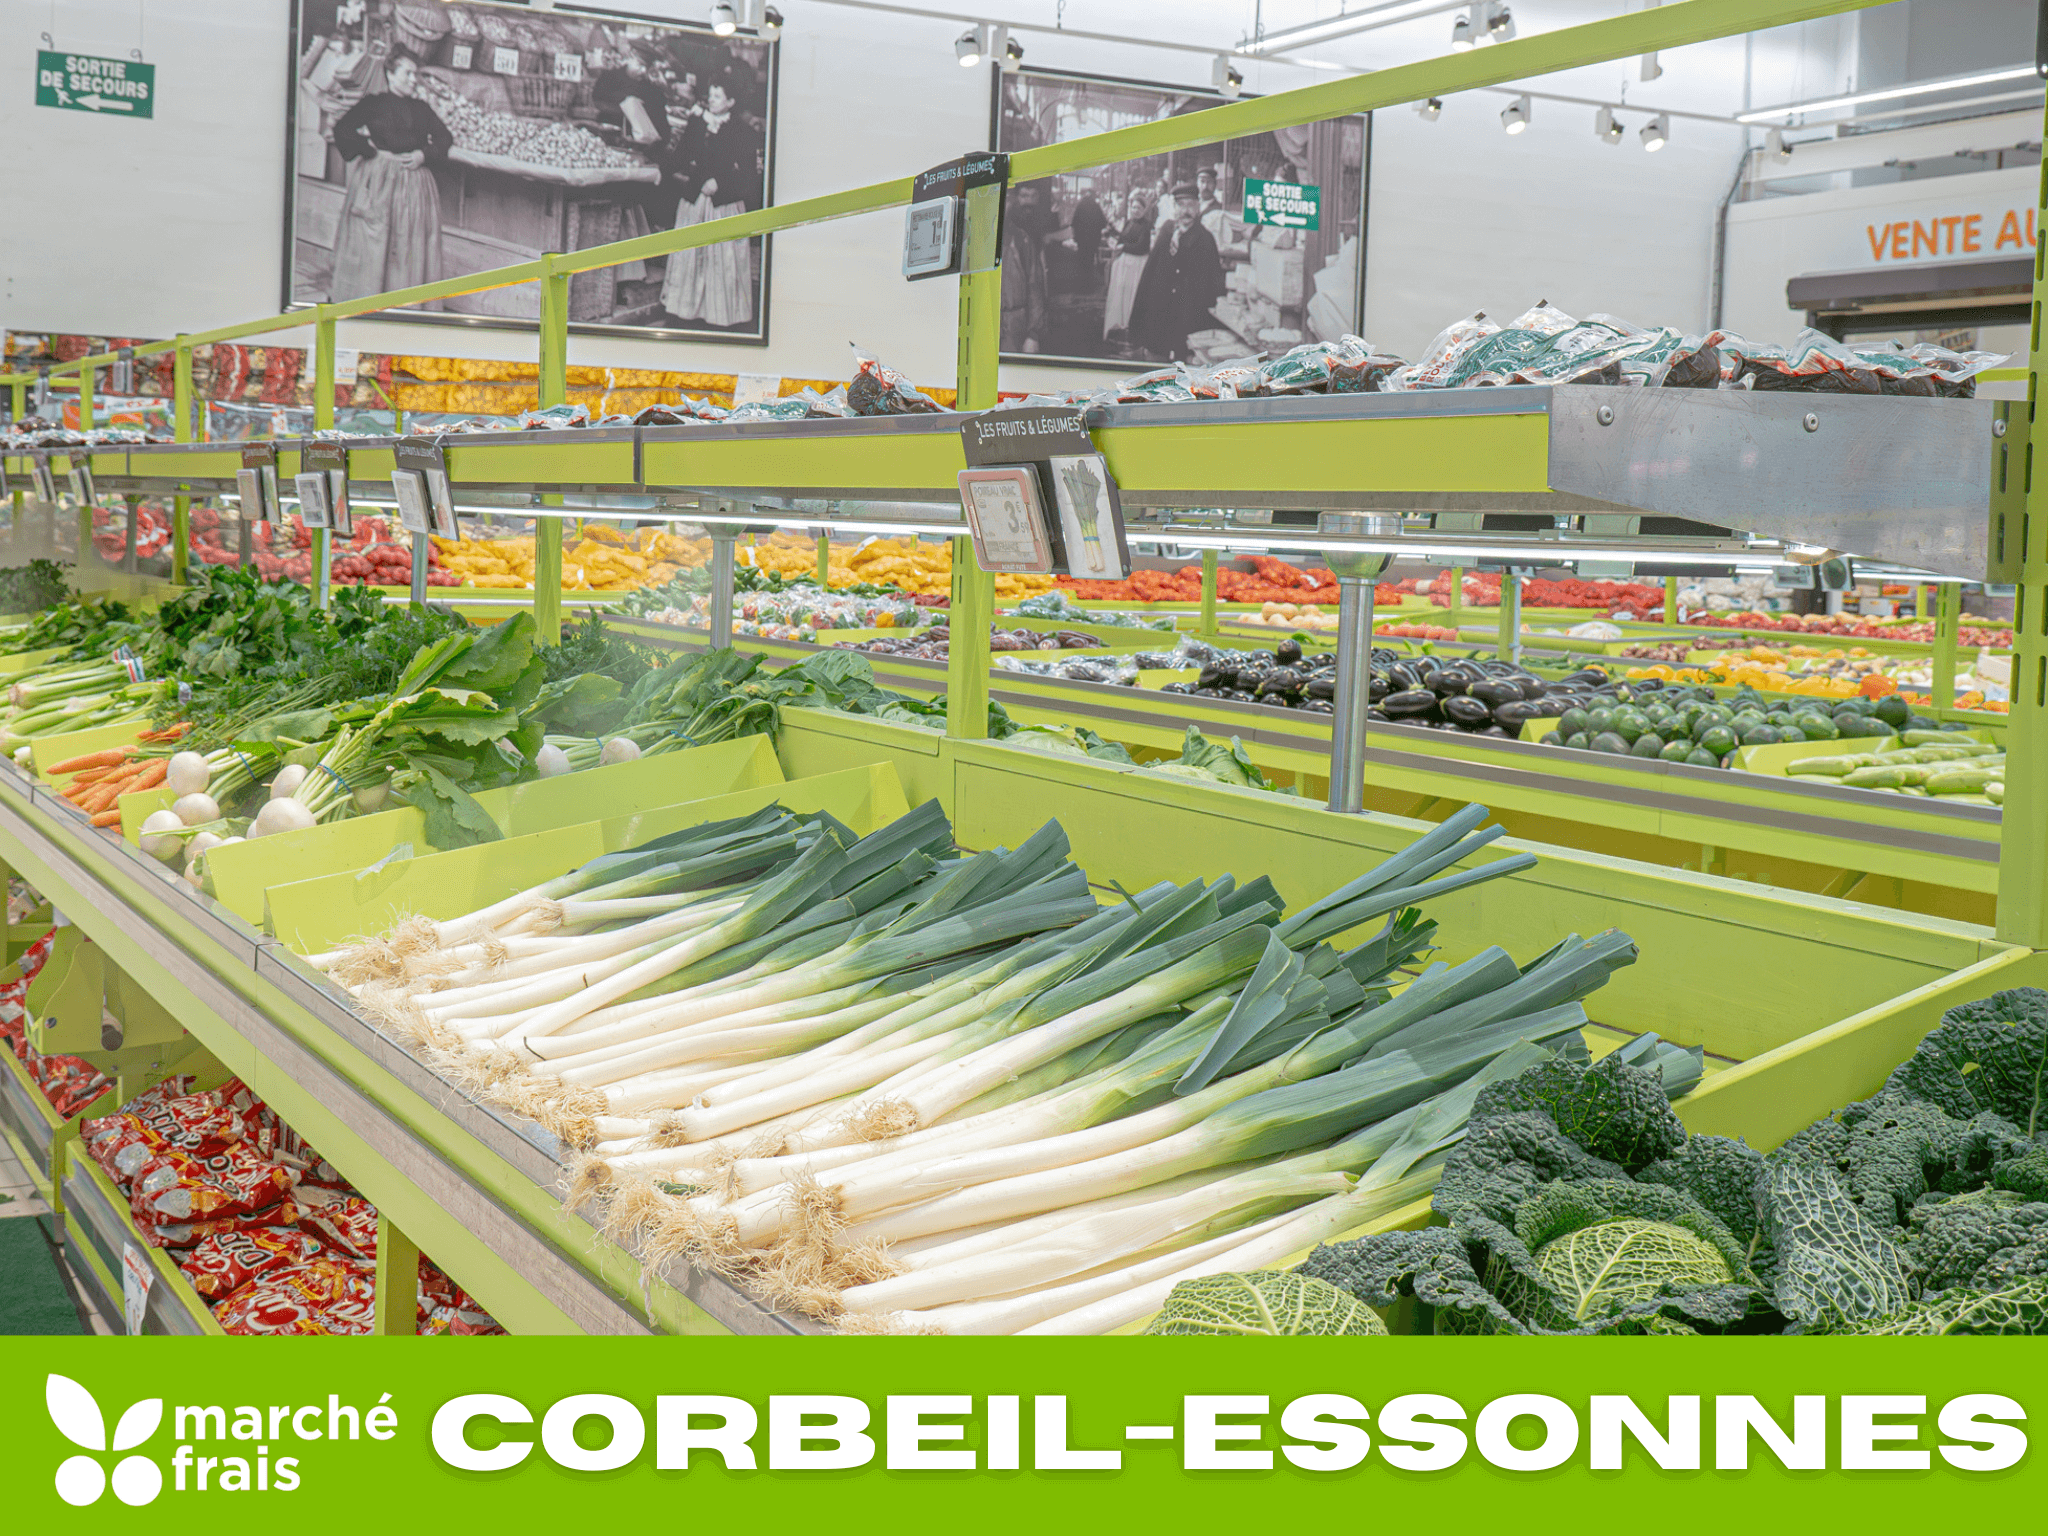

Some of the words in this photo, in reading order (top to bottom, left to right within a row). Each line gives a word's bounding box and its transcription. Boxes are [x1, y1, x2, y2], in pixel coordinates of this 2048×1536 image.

[65, 56, 126, 79] SORTIE
[40, 70, 64, 88] DE
[69, 73, 148, 99] SECOURS
[926, 173, 937, 186] LES
[937, 168, 956, 183] FRUITS
[962, 160, 993, 176] LÉGUMES
[1263, 182, 1302, 199] SORTIE
[1247, 194, 1262, 209] DE
[1265, 197, 1317, 215] SECOURS
[1867, 214, 1982, 261] VENTE
[979, 422, 995, 438] LES
[997, 421, 1027, 437] FRUITS
[1028, 420, 1036, 435] &
[1037, 415, 1081, 435] LÉGUMES
[1003, 500, 1020, 534] 3
